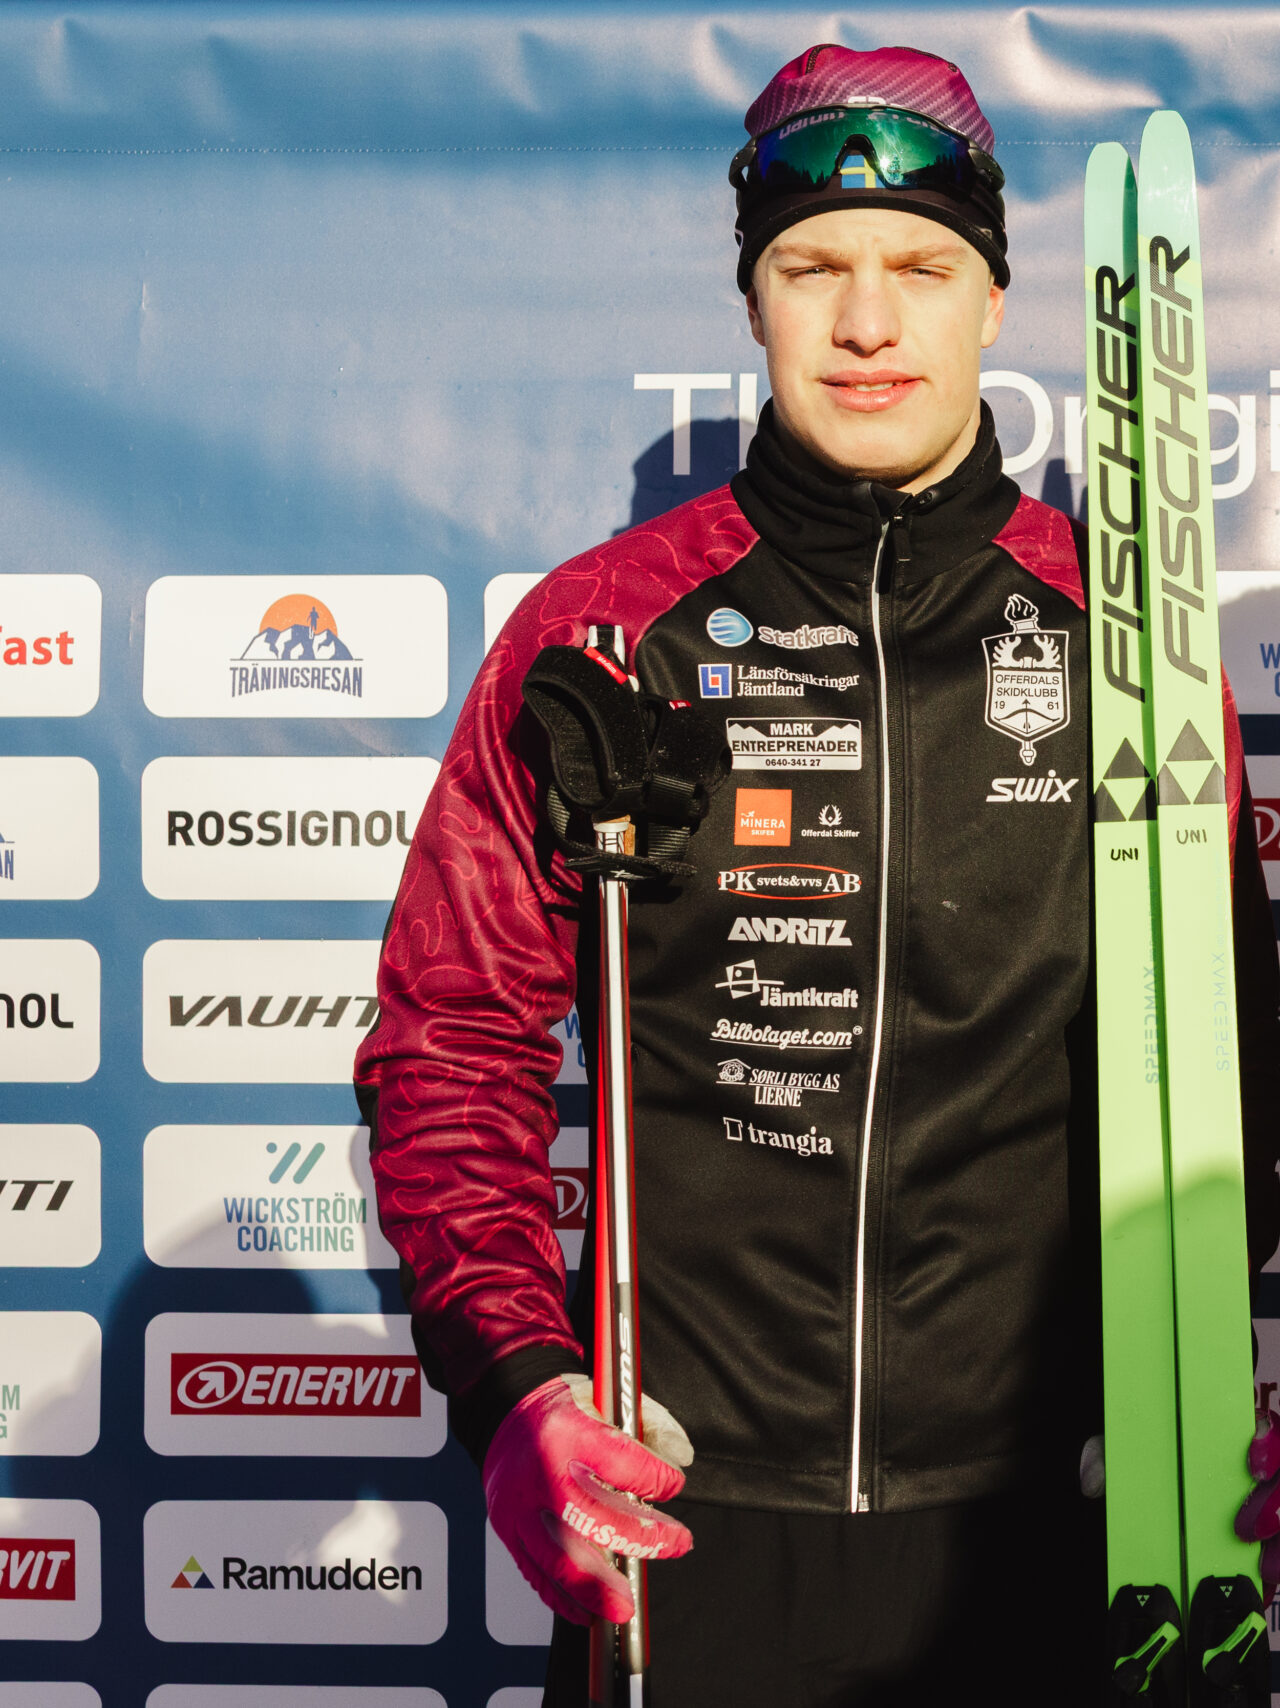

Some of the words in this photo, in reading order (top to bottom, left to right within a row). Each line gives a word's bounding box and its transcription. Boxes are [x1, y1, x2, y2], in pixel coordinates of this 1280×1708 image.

[1149, 235, 1208, 685] FISCHER
[1095, 265, 1145, 704] FISCHER
[0, 626, 75, 667] ast
[758, 623, 860, 650] Statkraft
[229, 662, 363, 699] TRÄNINGSRESAN
[737, 665, 860, 692] Länsförsäkringar
[737, 681, 805, 698] Jämtland
[995, 673, 1060, 686] OFFERDALS
[996, 687, 1058, 699] SKIDKLUBB
[994, 701, 1005, 710] 19
[1047, 701, 1060, 710] 61
[770, 723, 814, 736] MARK
[732, 740, 858, 753] ENTREPRENADER
[765, 758, 807, 767] 0640-341
[809, 758, 821, 767] 27
[167, 810, 413, 847] ROSSIGNOL
[740, 817, 786, 829] MINERA
[801, 829, 832, 838] Offerdal
[834, 829, 860, 838] Skiffer
[1176, 827, 1208, 846] UNI
[1109, 847, 1140, 862] UNI
[718, 871, 756, 891] PK
[757, 875, 823, 889] svets&vvs
[823, 873, 862, 893] AB
[760, 986, 859, 1008] Jämtkraft
[1211, 952, 1230, 1072] SPEEDMAX
[1143, 966, 1160, 1085] SPEEDMAX
[750, 1068, 786, 1085] SØRLI
[788, 1072, 820, 1088] BYGG
[822, 1073, 840, 1089] AS
[754, 1086, 802, 1107] LIERNE
[747, 1122, 834, 1156] trangia
[223, 1192, 367, 1224] WICKSTRÖM
[237, 1226, 354, 1253] COACHING
[243, 1367, 415, 1406] ENERVIT
[222, 1557, 422, 1591] Ramudden
